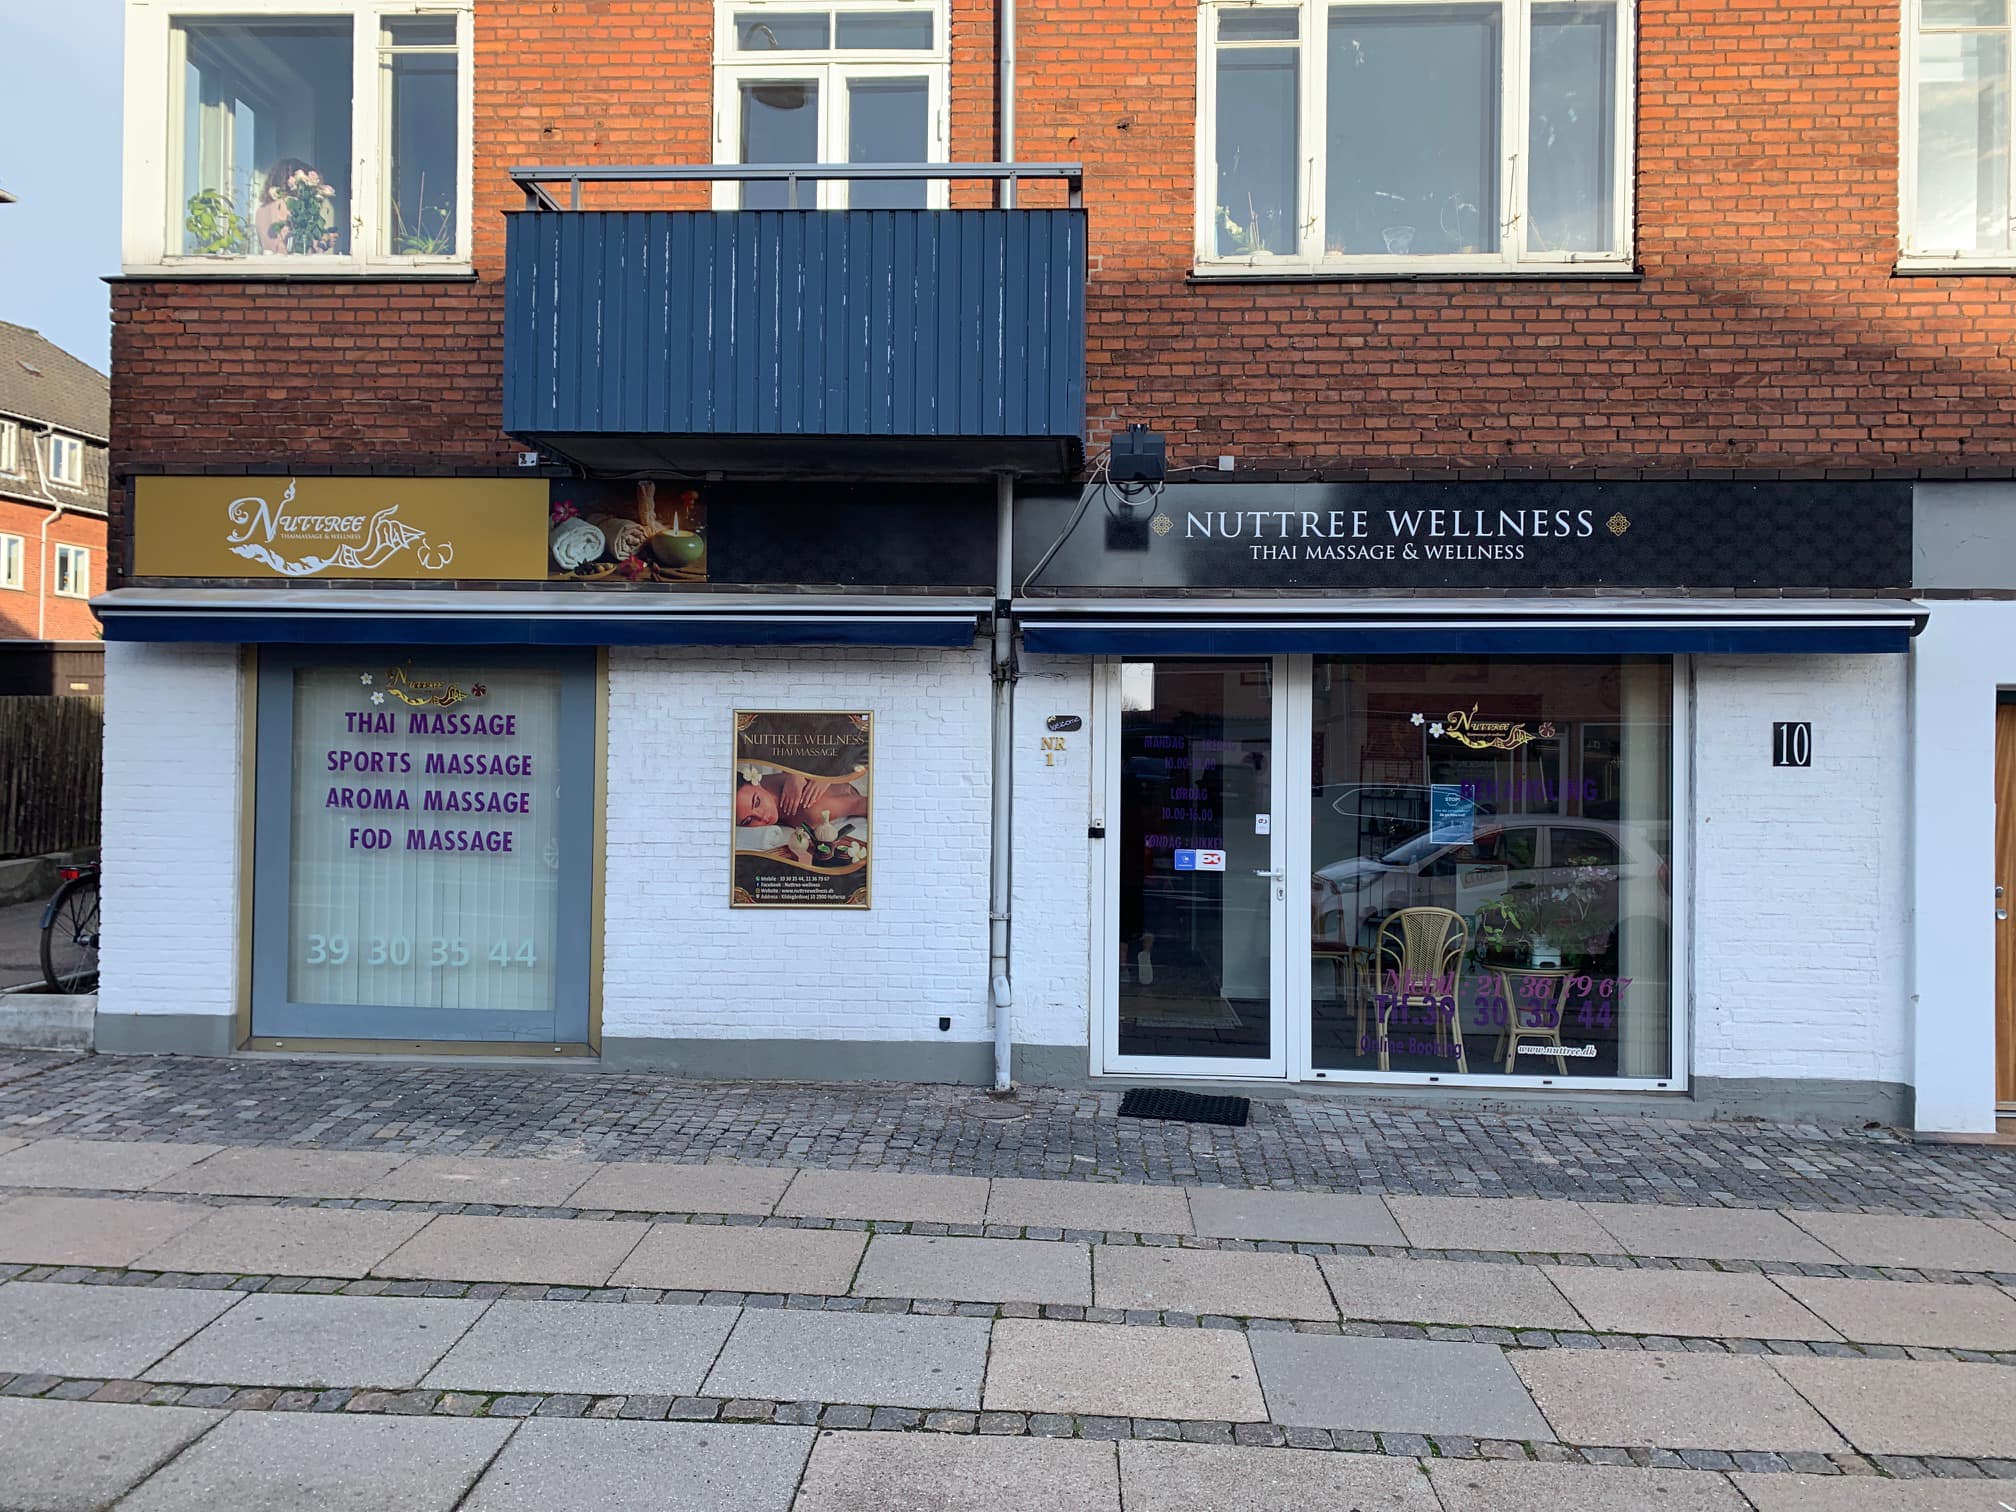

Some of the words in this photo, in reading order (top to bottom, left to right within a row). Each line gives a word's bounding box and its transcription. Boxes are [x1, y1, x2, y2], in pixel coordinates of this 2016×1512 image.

[1184, 511, 1369, 538] NUTTREE
[1386, 509, 1594, 538] WELLNESS
[1250, 545, 1298, 560] THAI
[1305, 544, 1396, 560] MASSAGE
[1402, 543, 1420, 560] &
[1425, 543, 1525, 560] WELLNESS
[345, 712, 395, 734] THAI
[408, 713, 516, 736] MASSAGE
[743, 734, 801, 745] NUTTREE
[804, 734, 865, 745] WELLNESS
[1041, 737, 1067, 751] NR
[1780, 723, 1809, 765] 10
[327, 751, 411, 773] SPORTS
[425, 753, 532, 776] MASSAGE
[772, 747, 794, 757] THAI
[795, 747, 838, 757] MASSAGE
[325, 788, 410, 810] AROMA
[423, 790, 530, 813] MASSAGE
[350, 828, 392, 849] FOD
[406, 829, 513, 852] MASSAGE
[307, 934, 349, 965] 39
[368, 935, 411, 966] 30
[428, 936, 471, 967] 35
[488, 937, 537, 968] 44
[1519, 976, 1552, 999] 36
[1473, 997, 1509, 1027] 30
[1577, 1000, 1614, 1030] 44
[1360, 1034, 1404, 1055] Online
[1518, 1043, 1597, 1058] www.nuttree.dk
